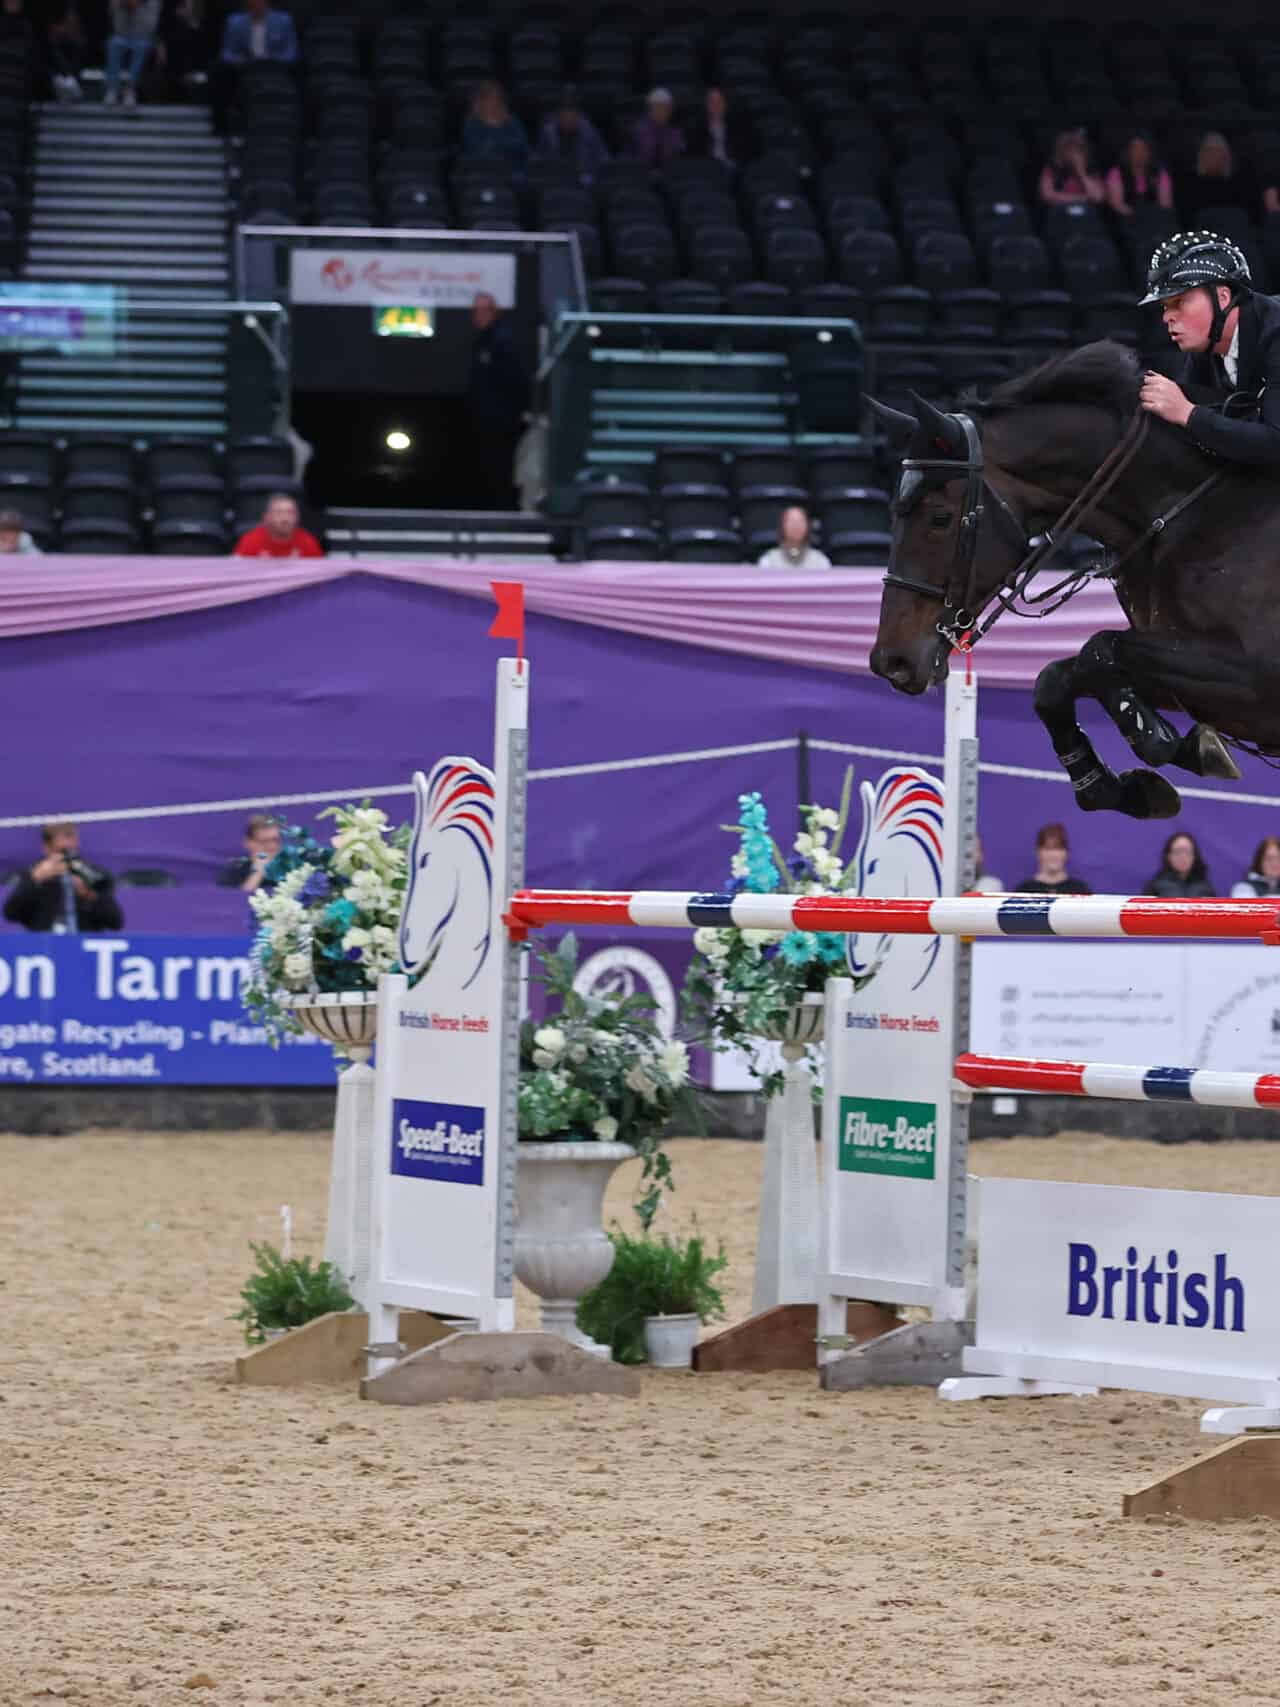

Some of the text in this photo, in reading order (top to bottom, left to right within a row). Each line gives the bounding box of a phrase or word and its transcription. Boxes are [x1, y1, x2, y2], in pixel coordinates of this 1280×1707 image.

[0, 939, 255, 1001] n Tarm
[62, 1018, 185, 1051] Recycling
[210, 1019, 276, 1046] Plan
[42, 1051, 161, 1077] Scotland.
[844, 1111, 937, 1153] Fibre-Beet
[1066, 1242, 1246, 1333] British
